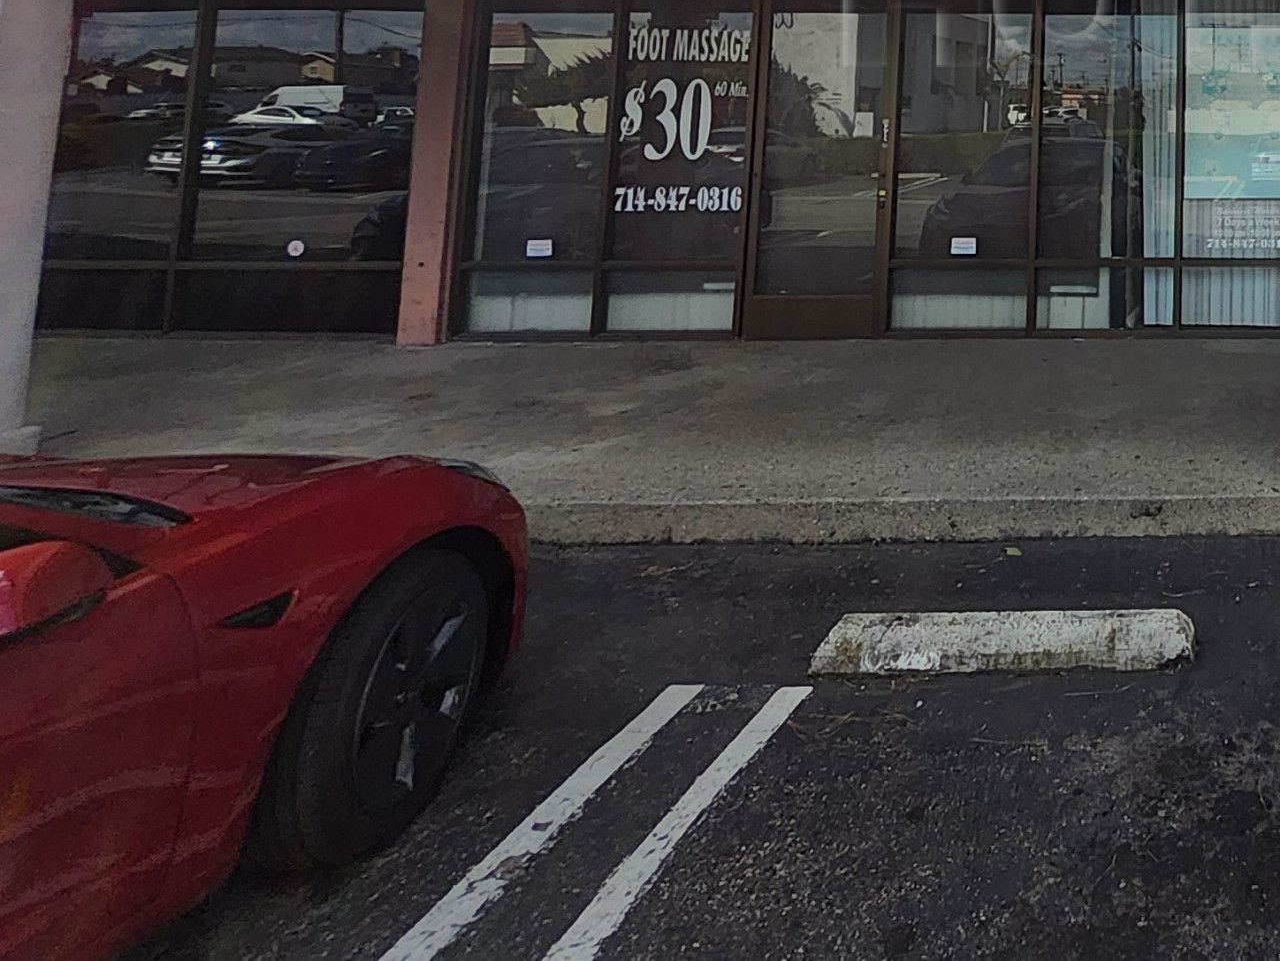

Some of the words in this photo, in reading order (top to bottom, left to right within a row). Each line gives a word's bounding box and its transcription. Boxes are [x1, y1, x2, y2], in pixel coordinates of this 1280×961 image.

[628, 27, 669, 61] FOOT
[673, 28, 752, 62] MASSAGE
[619, 78, 712, 160] $30
[714, 81, 727, 97] 60
[614, 186, 742, 212] 714-847-0316
